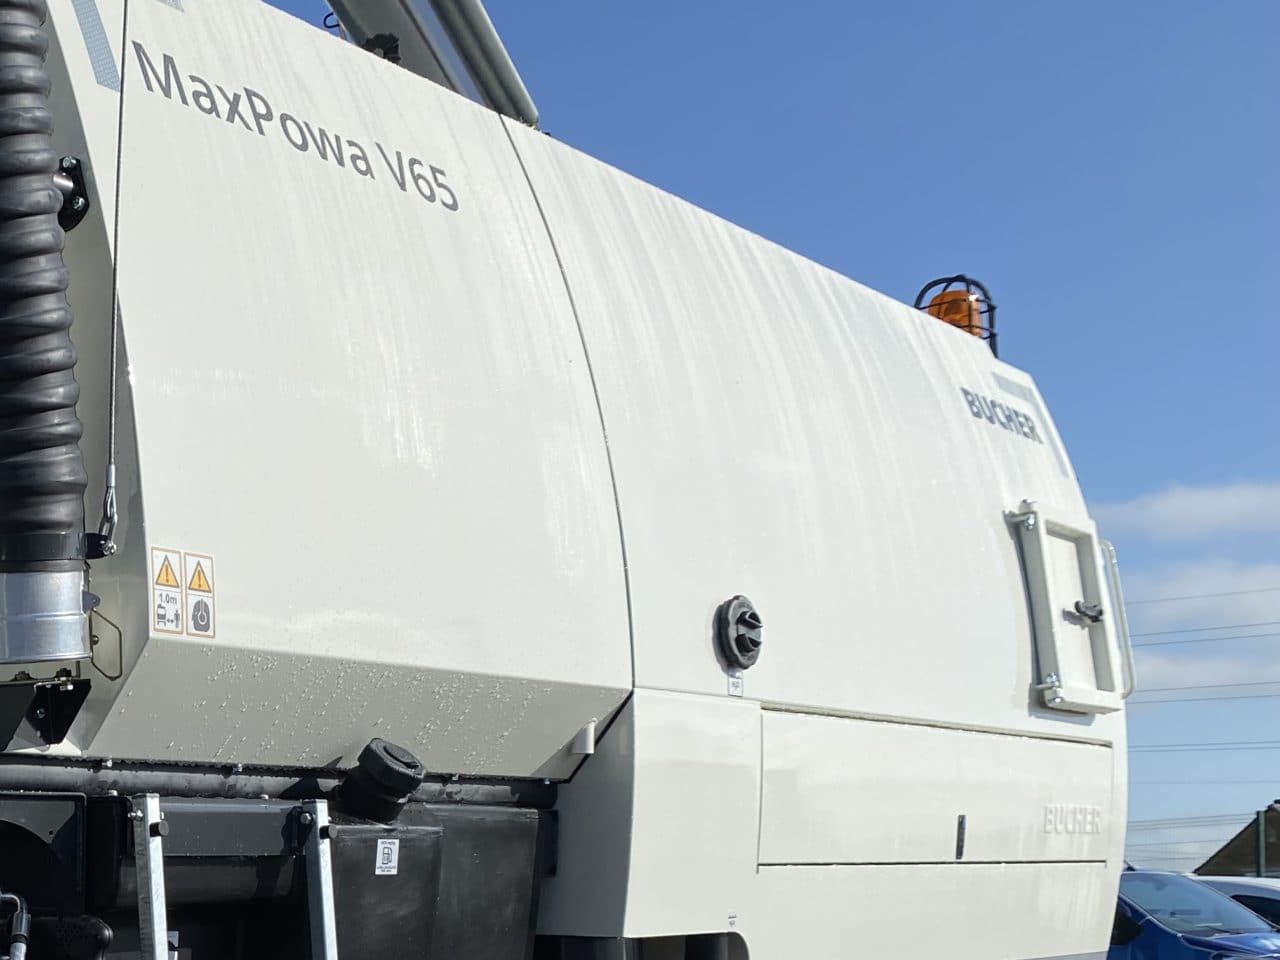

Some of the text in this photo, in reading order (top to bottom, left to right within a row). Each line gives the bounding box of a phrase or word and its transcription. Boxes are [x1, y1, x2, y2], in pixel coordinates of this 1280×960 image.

[131, 39, 459, 212] MaxPowa V65
[960, 386, 1043, 444] BUCHER
[1043, 805, 1101, 834] BUCHER
